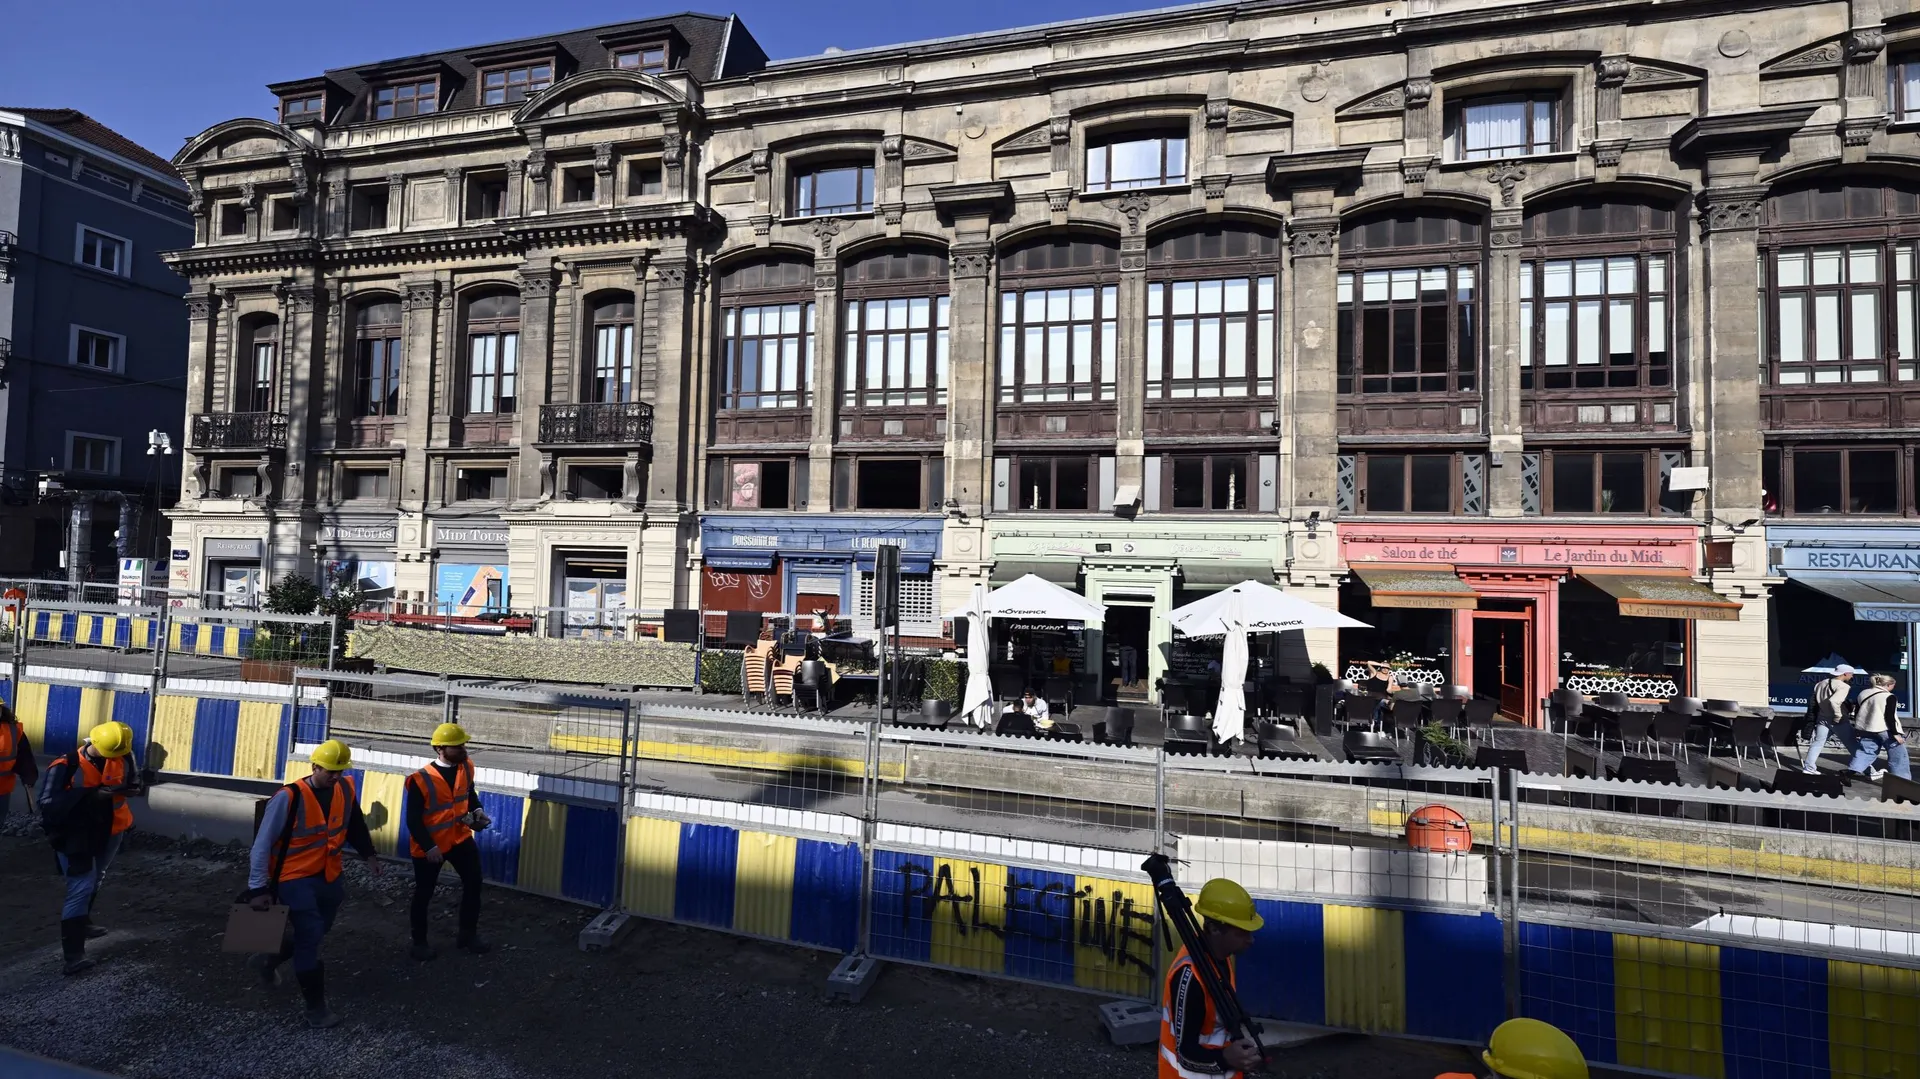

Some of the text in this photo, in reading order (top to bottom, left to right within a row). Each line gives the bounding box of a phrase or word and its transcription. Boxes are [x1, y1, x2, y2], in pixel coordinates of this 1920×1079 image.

[354, 528, 393, 539] TOURS
[438, 529, 511, 541] MIDI TOURS
[851, 537, 860, 548] LE
[1381, 545, 1458, 560] Salon de thé
[1544, 548, 1663, 563] Le Jardin du Midi
